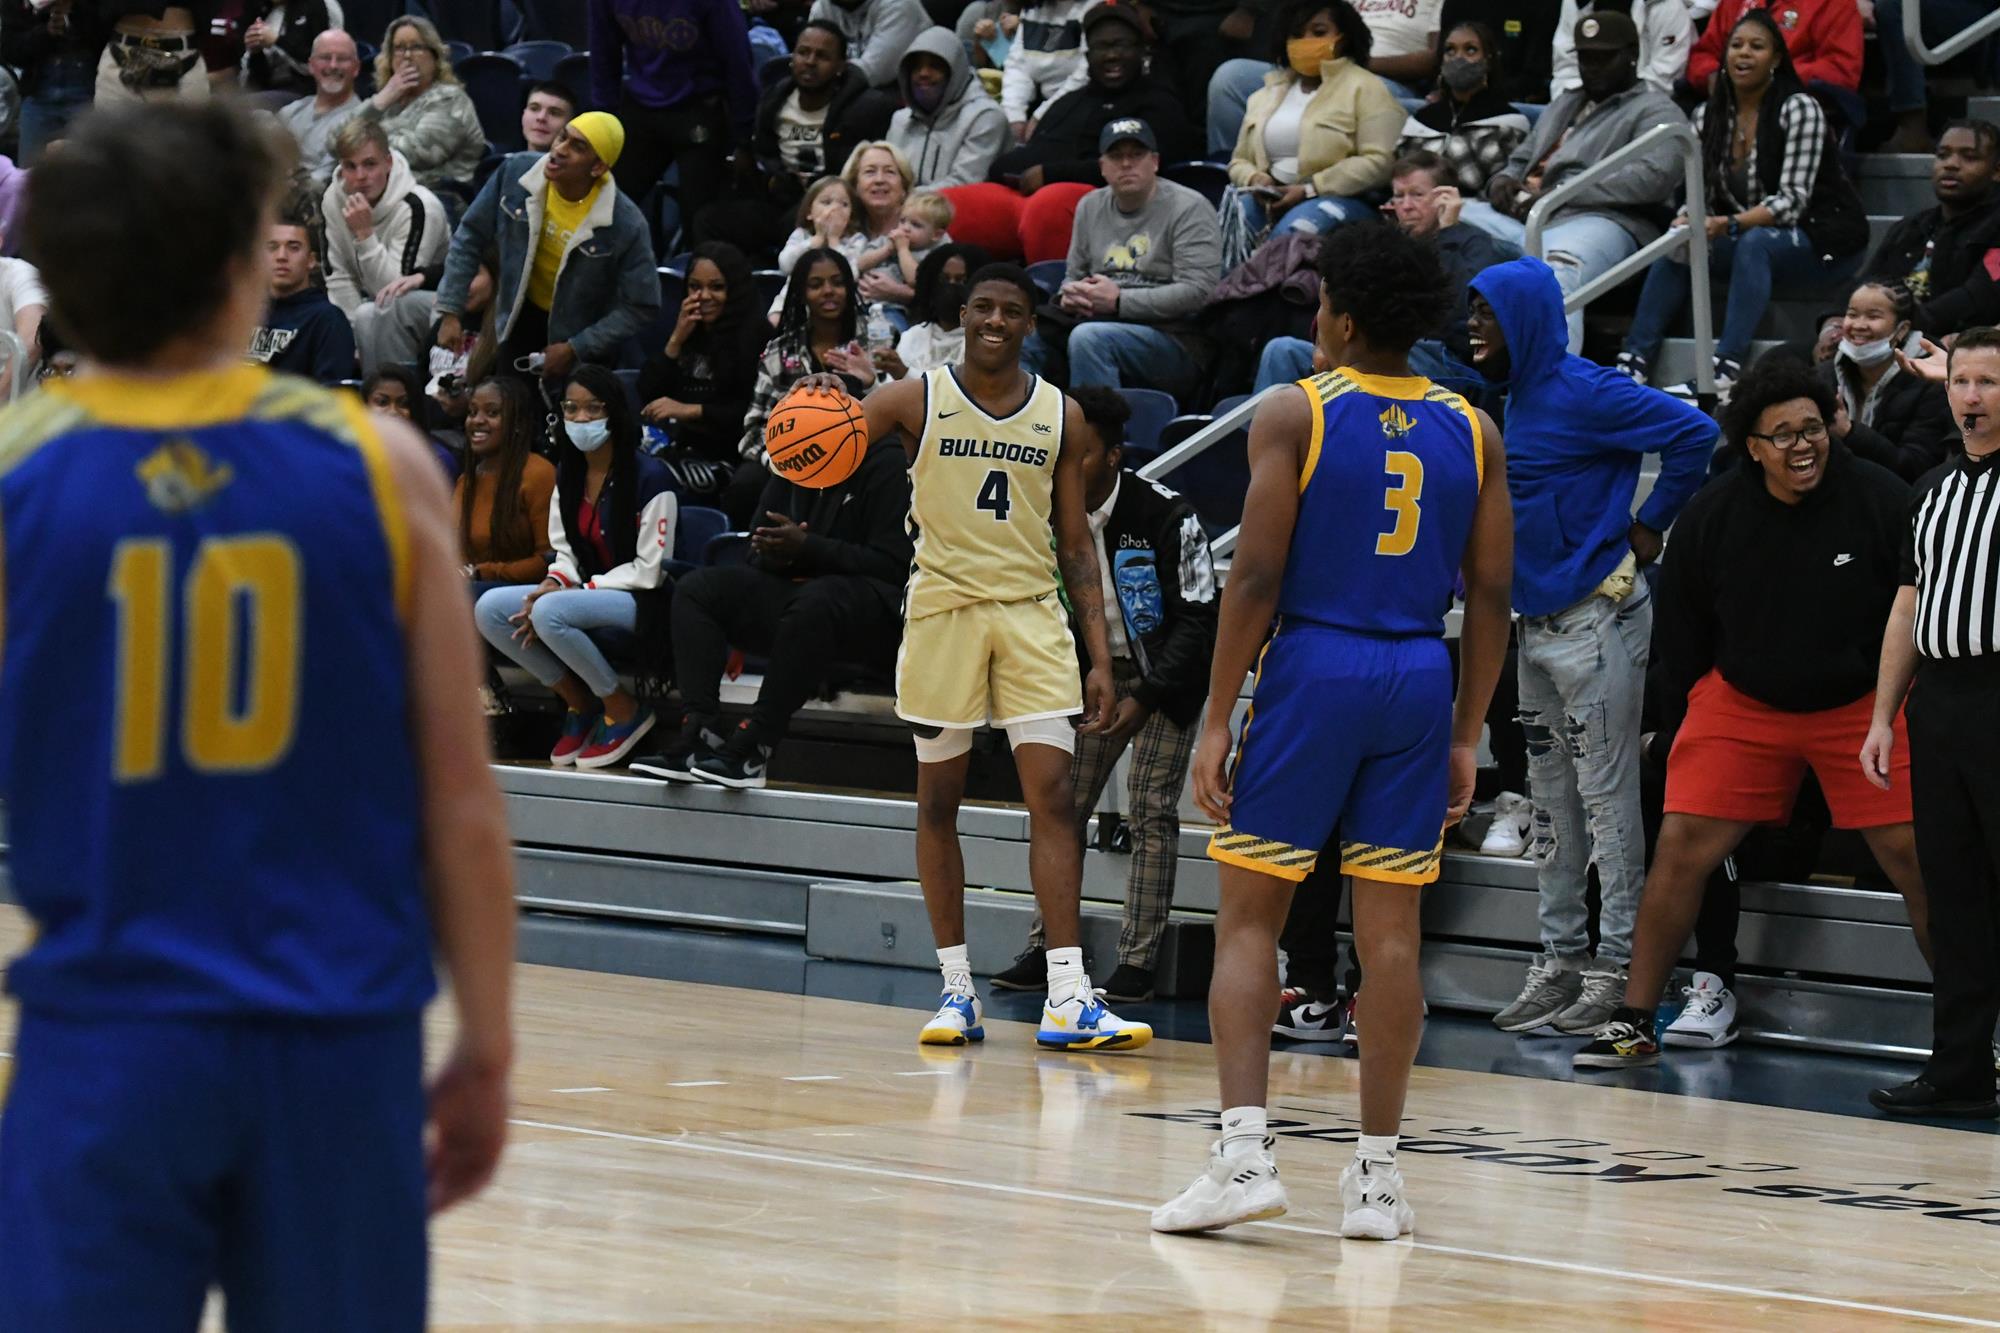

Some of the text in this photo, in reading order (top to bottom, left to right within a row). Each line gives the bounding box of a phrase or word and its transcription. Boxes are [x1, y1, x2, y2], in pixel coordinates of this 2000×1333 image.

[938, 438, 1049, 467] BULLDOGS
[1034, 423, 1052, 433] SAC
[975, 468, 1011, 522] 4
[1374, 449, 1424, 556] 3
[108, 535, 304, 780] 10
